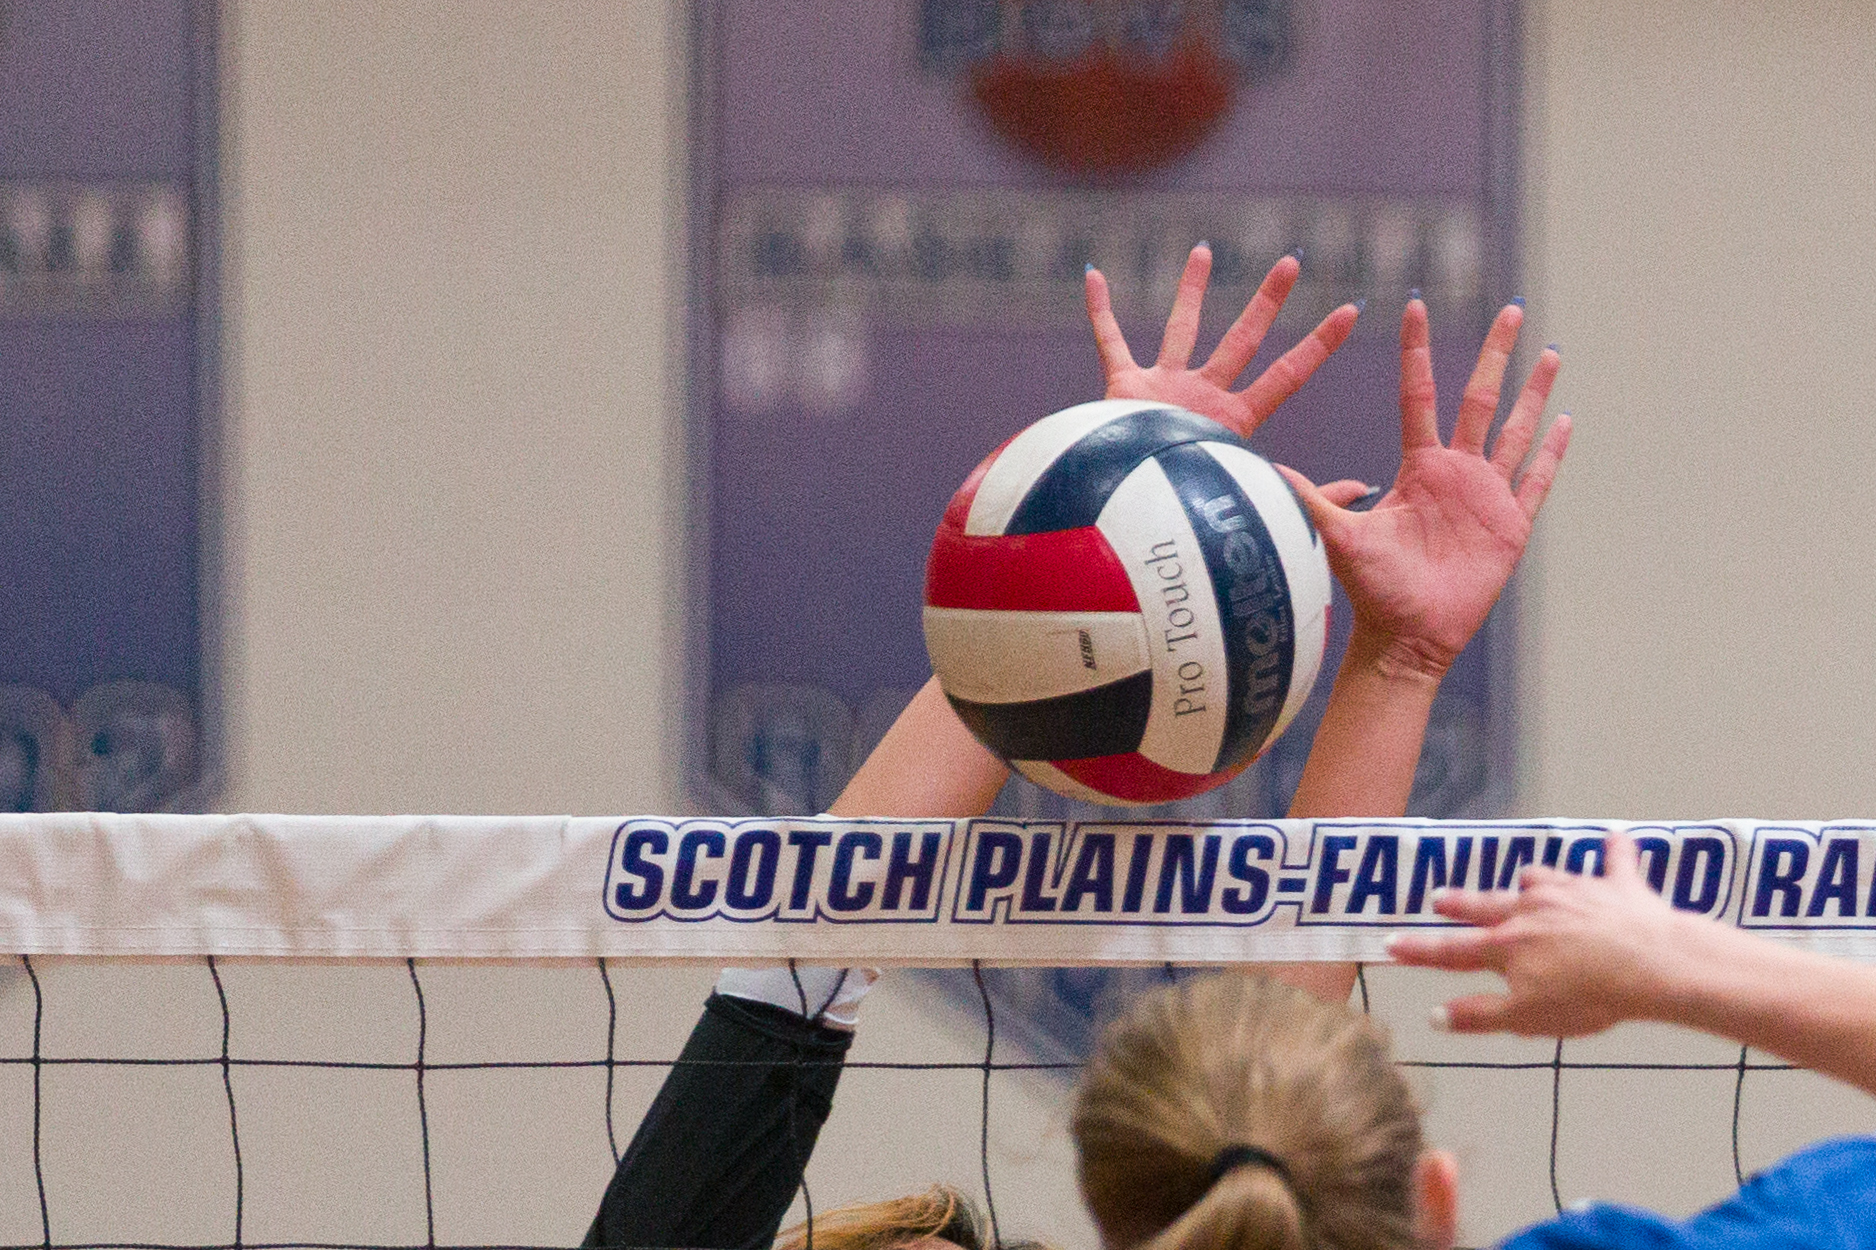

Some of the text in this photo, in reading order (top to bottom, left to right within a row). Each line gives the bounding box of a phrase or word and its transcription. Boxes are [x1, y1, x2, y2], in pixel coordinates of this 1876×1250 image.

[1144, 538, 1206, 717] Pro Touch
[1203, 493, 1281, 720] molten
[612, 829, 942, 913] SCOTCH
